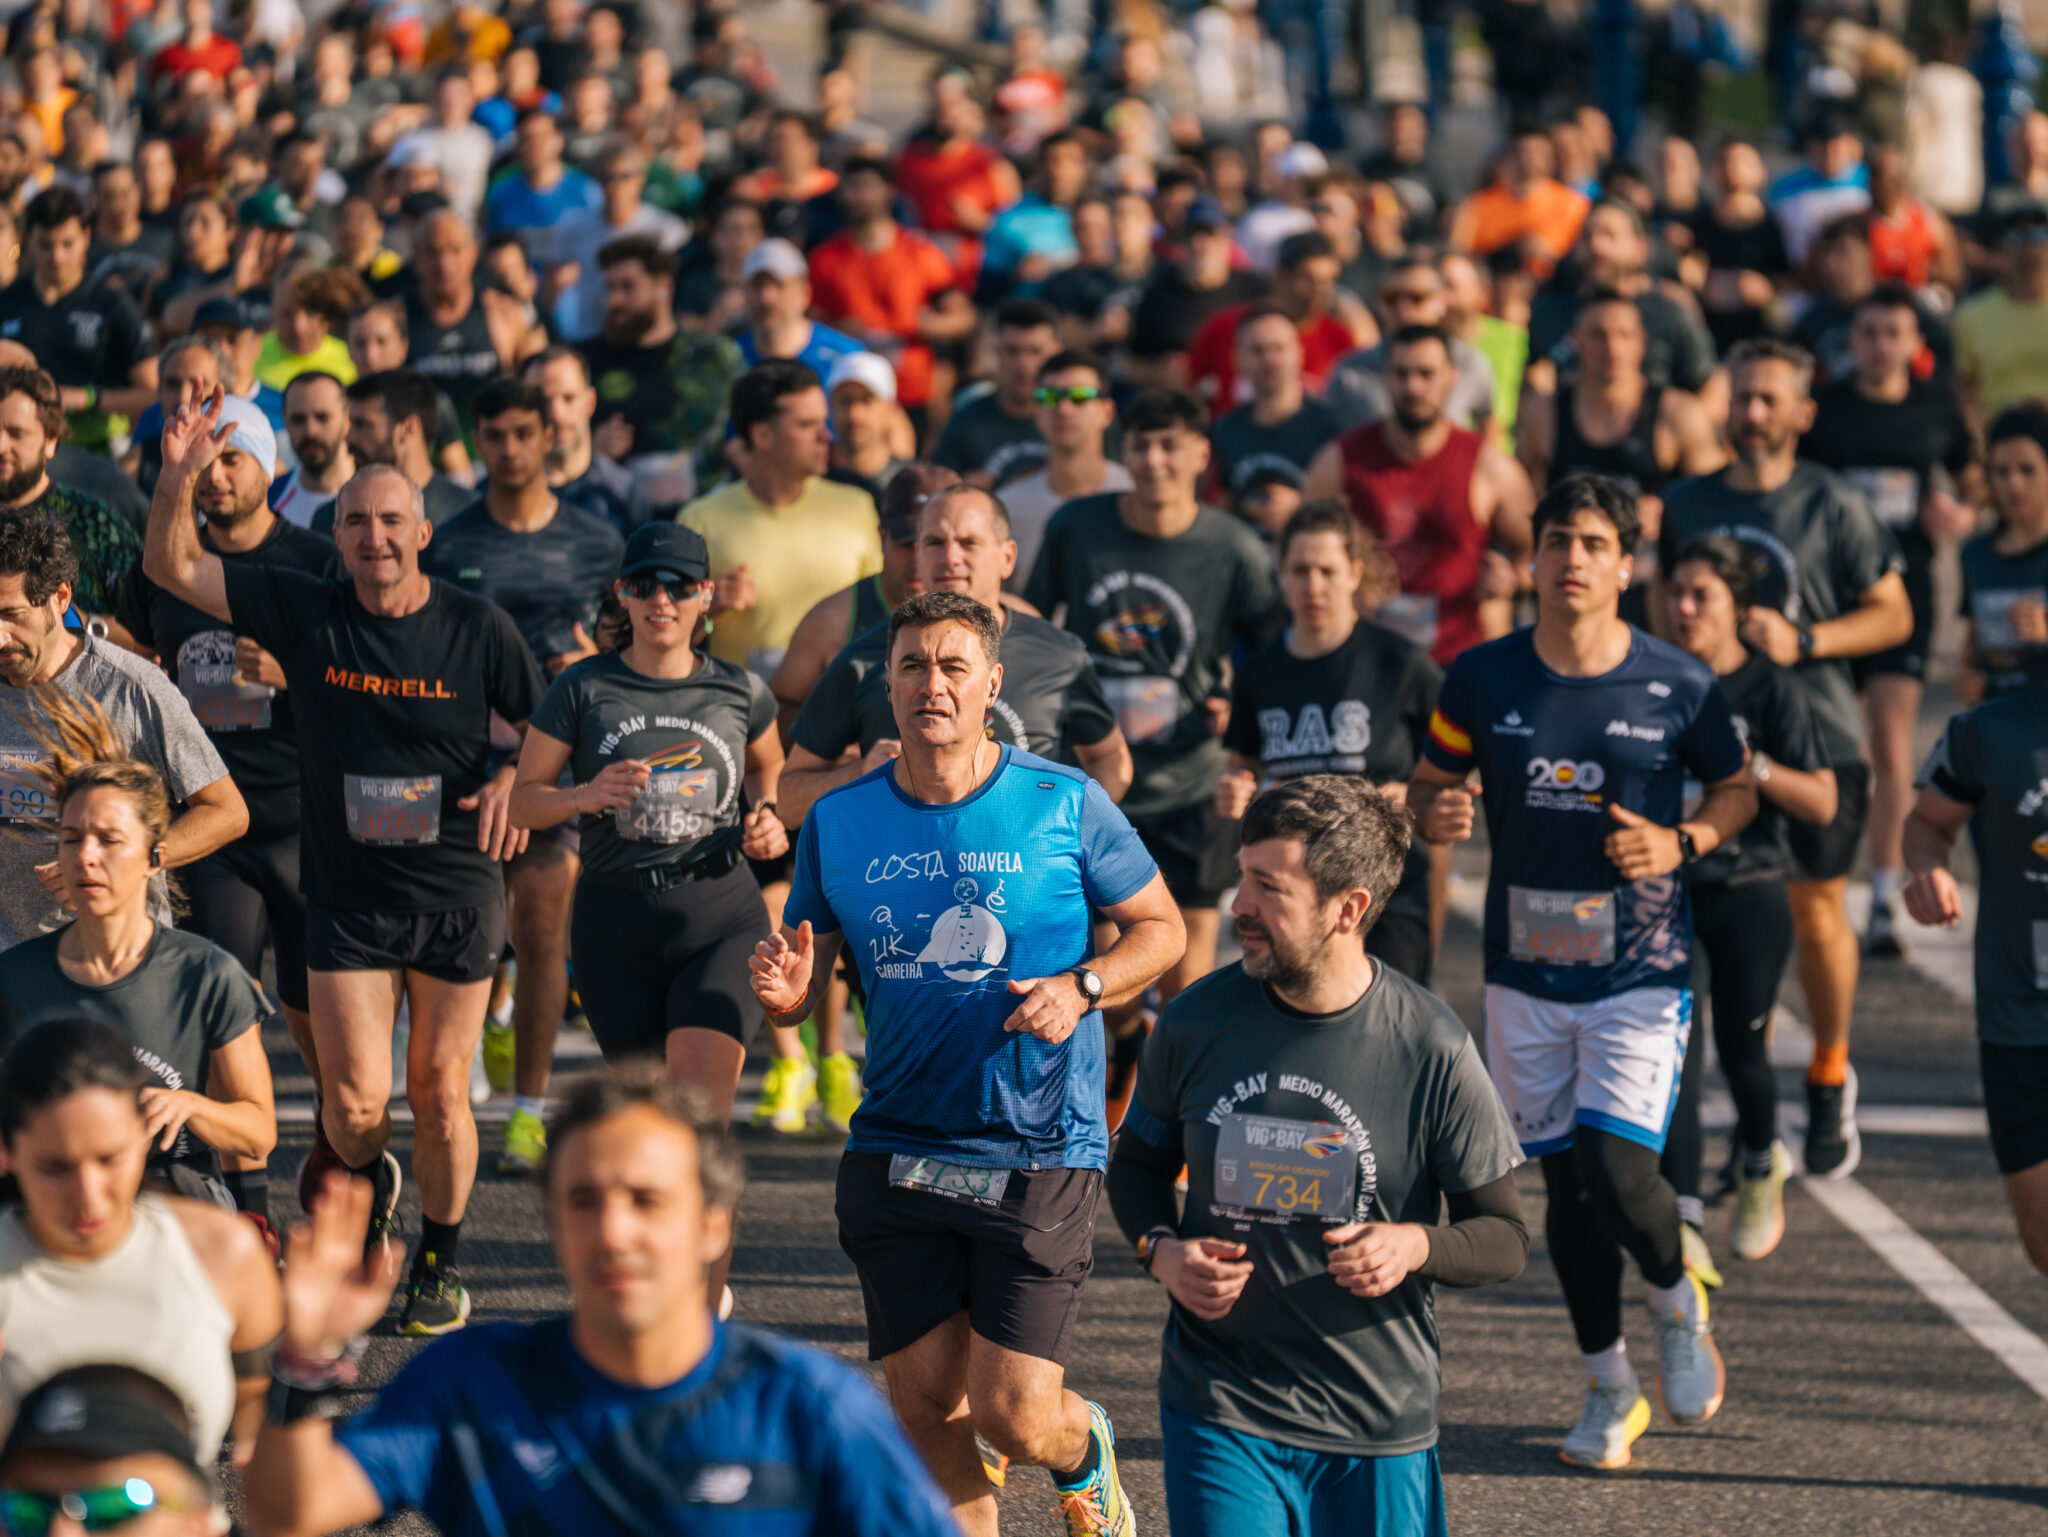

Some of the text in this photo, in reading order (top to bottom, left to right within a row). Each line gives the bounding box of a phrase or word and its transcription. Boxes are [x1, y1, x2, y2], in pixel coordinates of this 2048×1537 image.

[325, 665, 452, 698] MERRELL
[994, 698, 1026, 737] ARATÓN
[598, 715, 646, 755] VIG-BAY
[655, 715, 691, 730] MEDIO
[691, 721, 734, 763] MARATÓN
[361, 812, 429, 839] 3053
[634, 811, 702, 837] 4455
[865, 850, 1023, 884] COSTA SOAVELA
[1527, 930, 1602, 960] 4205
[875, 962, 923, 980] CARREIRA
[1206, 1072, 1378, 1226] VIG-BAY MEDIO MARATÓN GRAN BAH
[1253, 1172, 1323, 1212] 734
